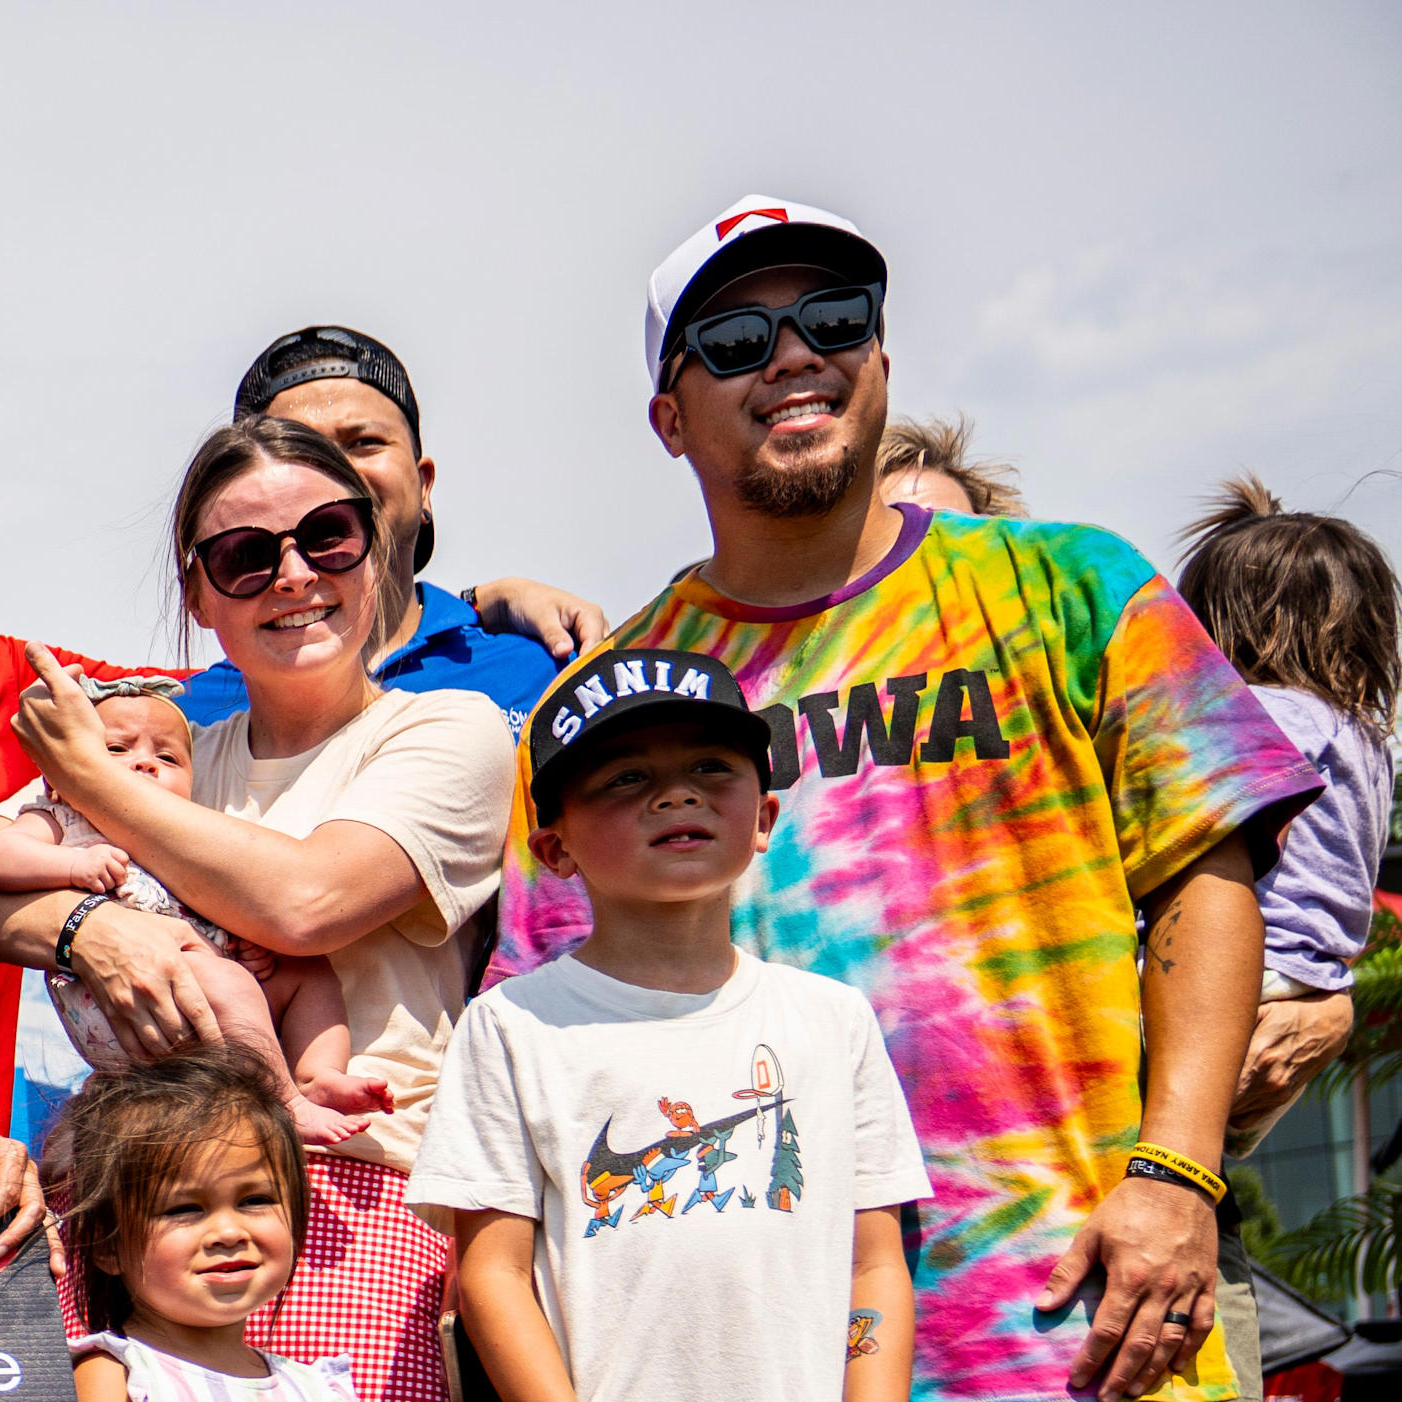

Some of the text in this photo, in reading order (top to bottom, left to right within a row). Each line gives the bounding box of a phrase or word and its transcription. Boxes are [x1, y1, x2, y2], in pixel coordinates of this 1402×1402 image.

[65, 906, 88, 931] Fair
[1170, 1158, 1200, 1175] ARMY
[1201, 1172, 1221, 1191] IOWA
